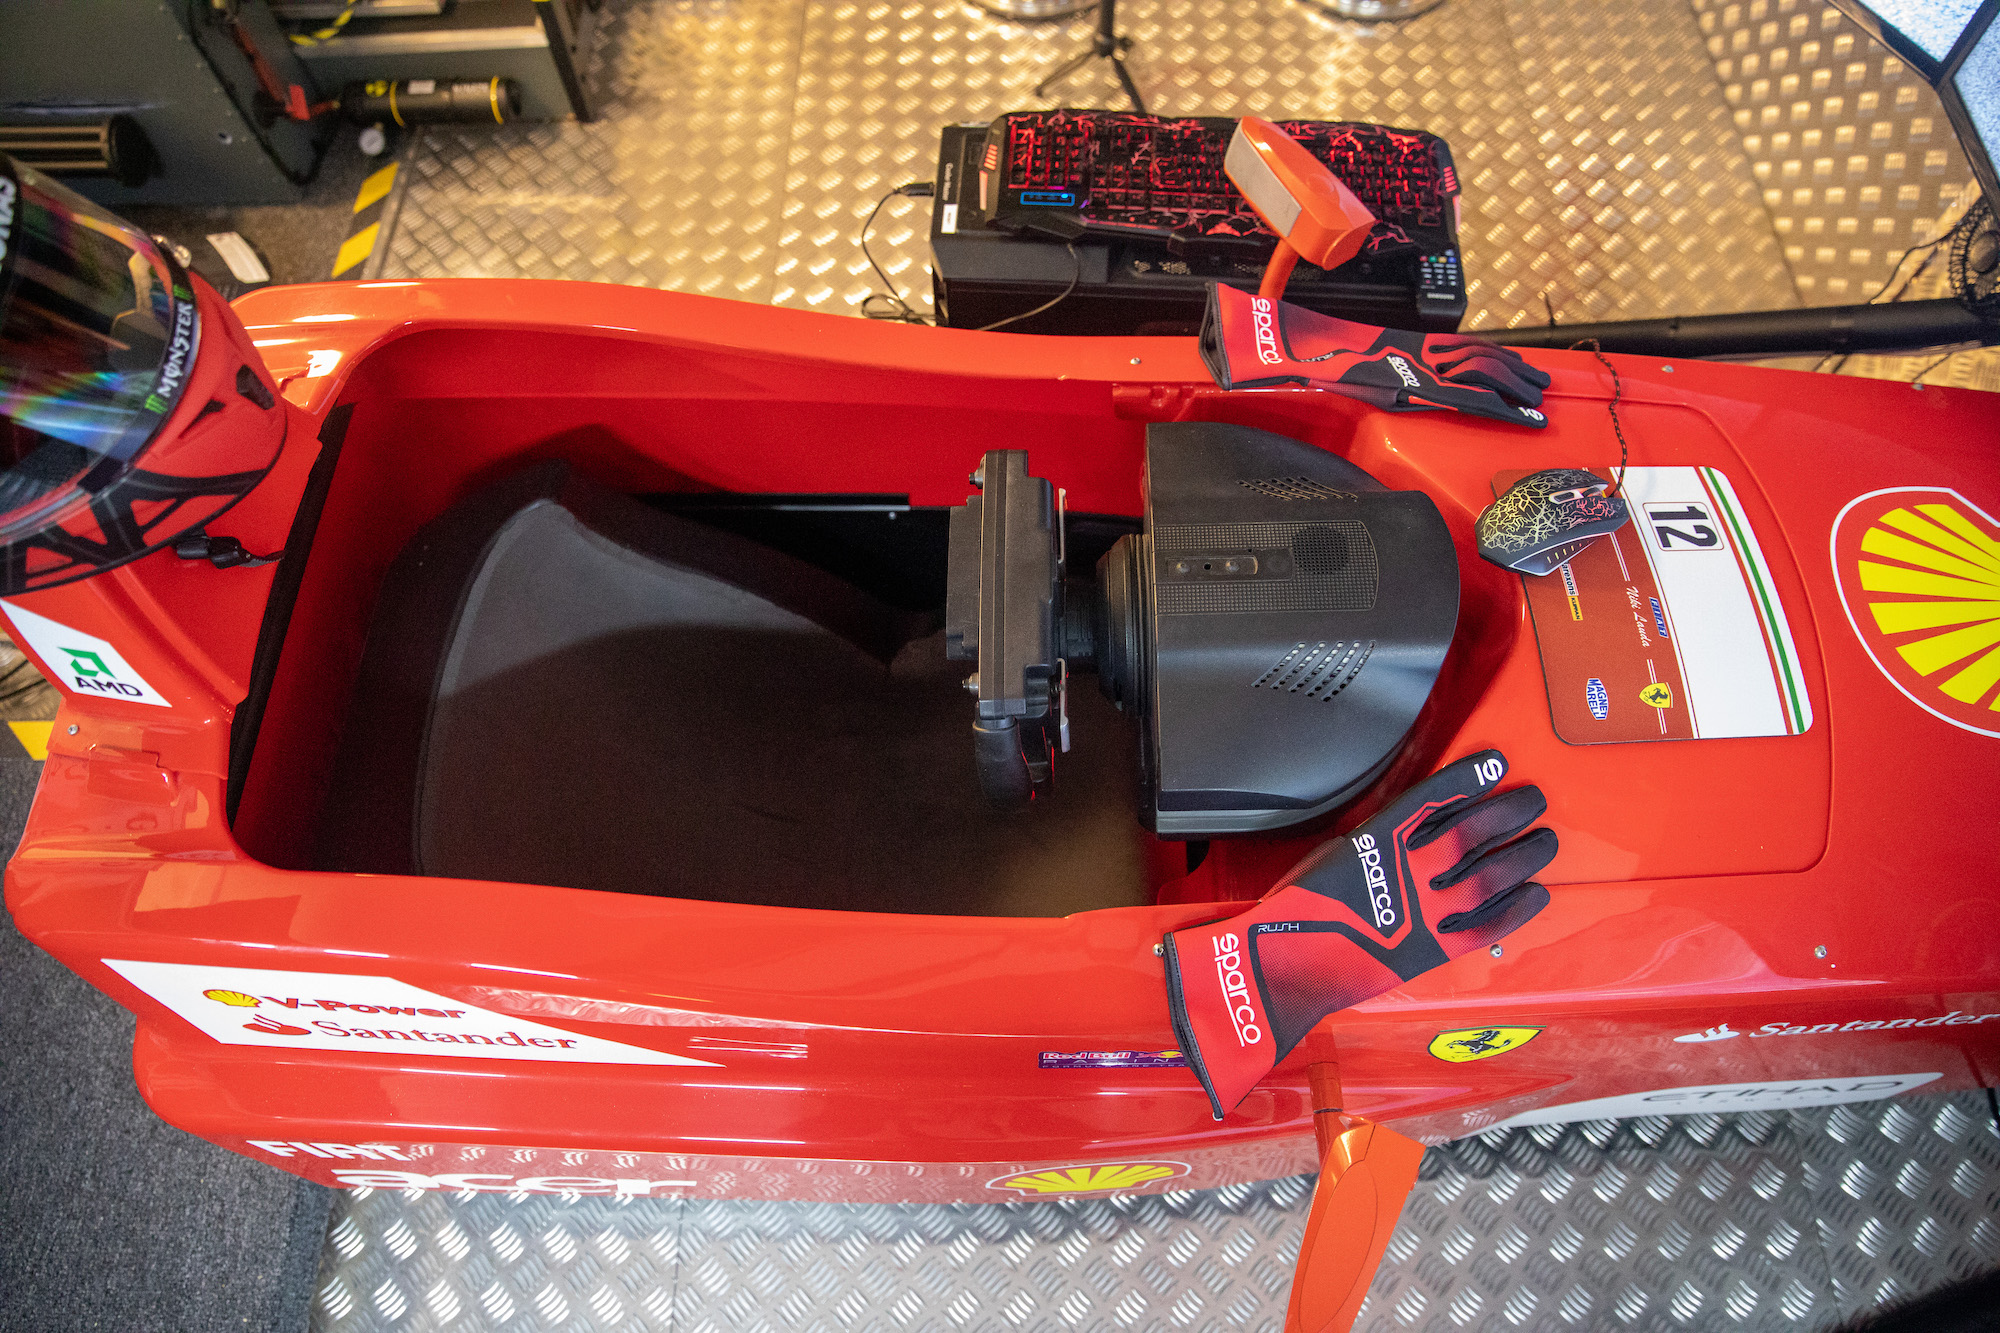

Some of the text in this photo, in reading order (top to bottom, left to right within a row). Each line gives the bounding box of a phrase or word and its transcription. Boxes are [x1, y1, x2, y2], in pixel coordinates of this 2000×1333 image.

[1251, 297, 1283, 365] sparco
[157, 301, 194, 398] MONSTER
[1386, 355, 1421, 388] sparco
[1649, 506, 1718, 548] 12
[1626, 586, 1652, 648] Niki Lauda
[1649, 597, 1668, 638] FIAT
[75, 676, 144, 697] AMD
[1352, 833, 1396, 928] sparco
[1257, 922, 1300, 933] RUSH
[1212, 933, 1262, 1047] sparco
[259, 996, 466, 1019] V-Power
[311, 1020, 577, 1049] Santander
[1749, 1010, 2000, 1037] Santander
[1088, 1051, 1131, 1059] Bull
[1642, 1081, 1903, 1102] ETIHAD
[246, 1140, 413, 1162] FIAT
[331, 1169, 697, 1195] acer
